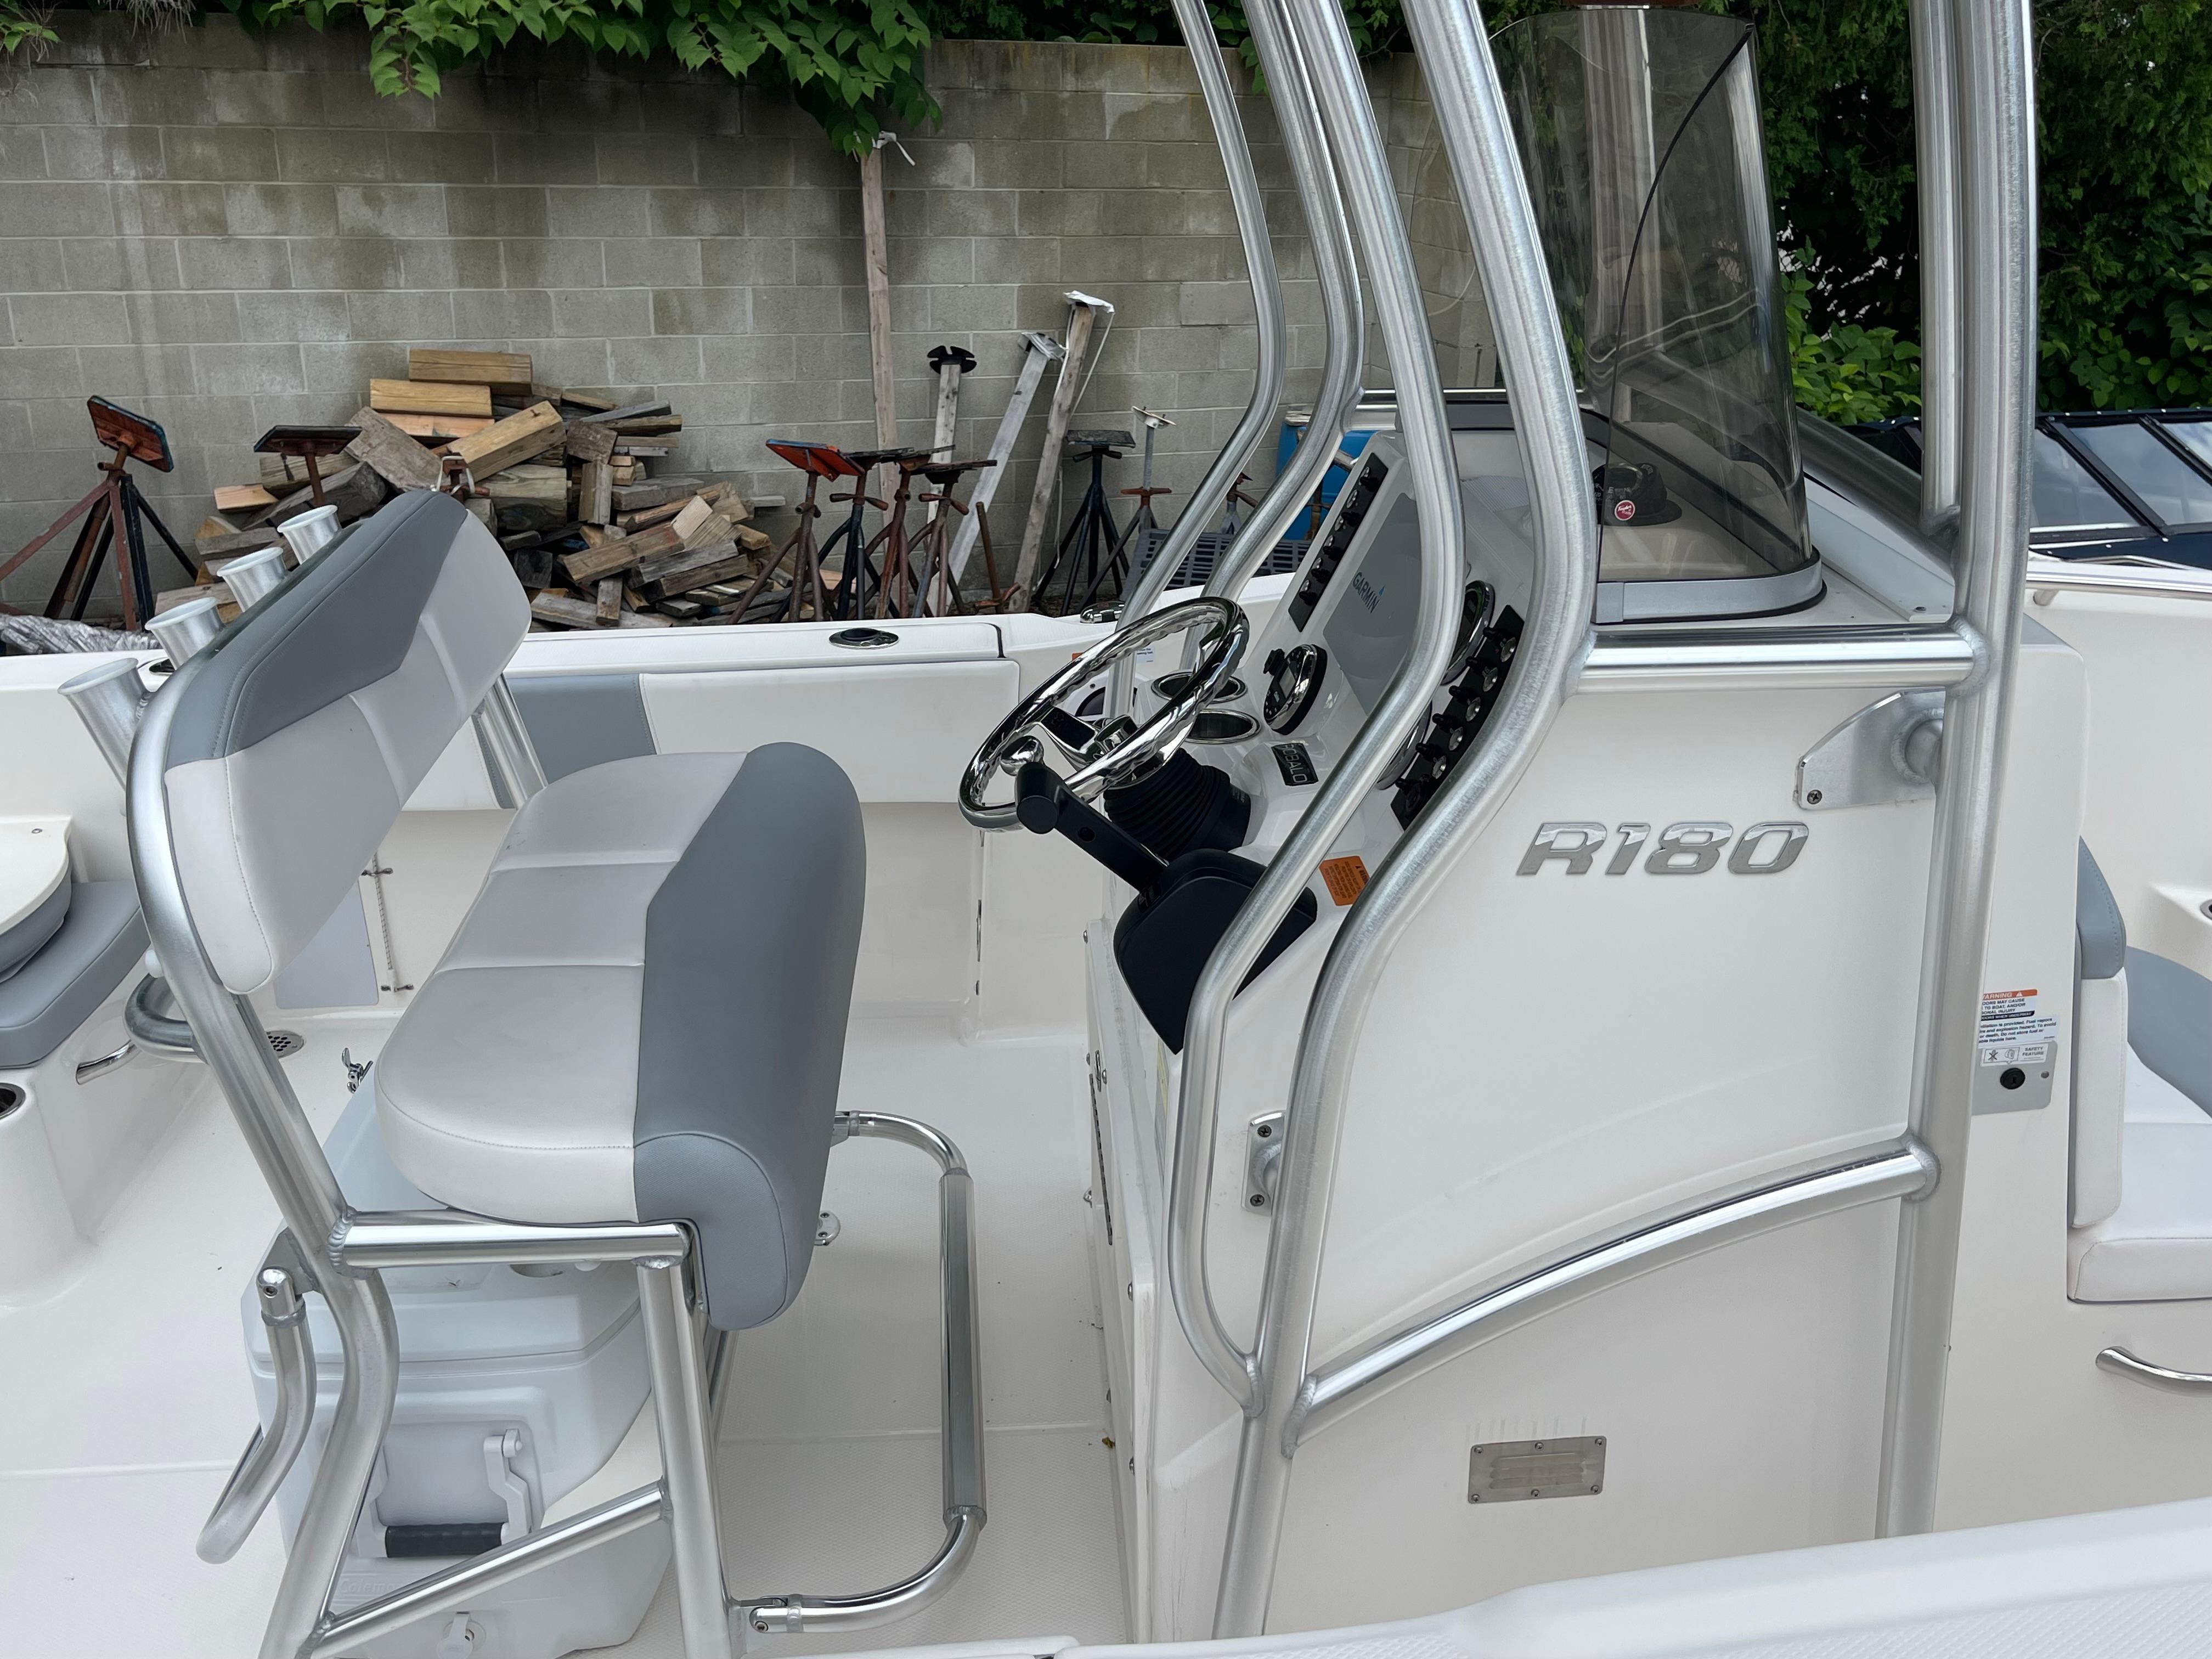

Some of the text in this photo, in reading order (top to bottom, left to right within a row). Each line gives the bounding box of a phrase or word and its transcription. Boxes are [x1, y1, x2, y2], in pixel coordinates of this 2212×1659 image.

[1352, 572, 1380, 614] GARMIN
[1282, 744, 1307, 782] ROBALO
[1516, 822, 1809, 876] R180
[341, 1578, 399, 1594] Colema
